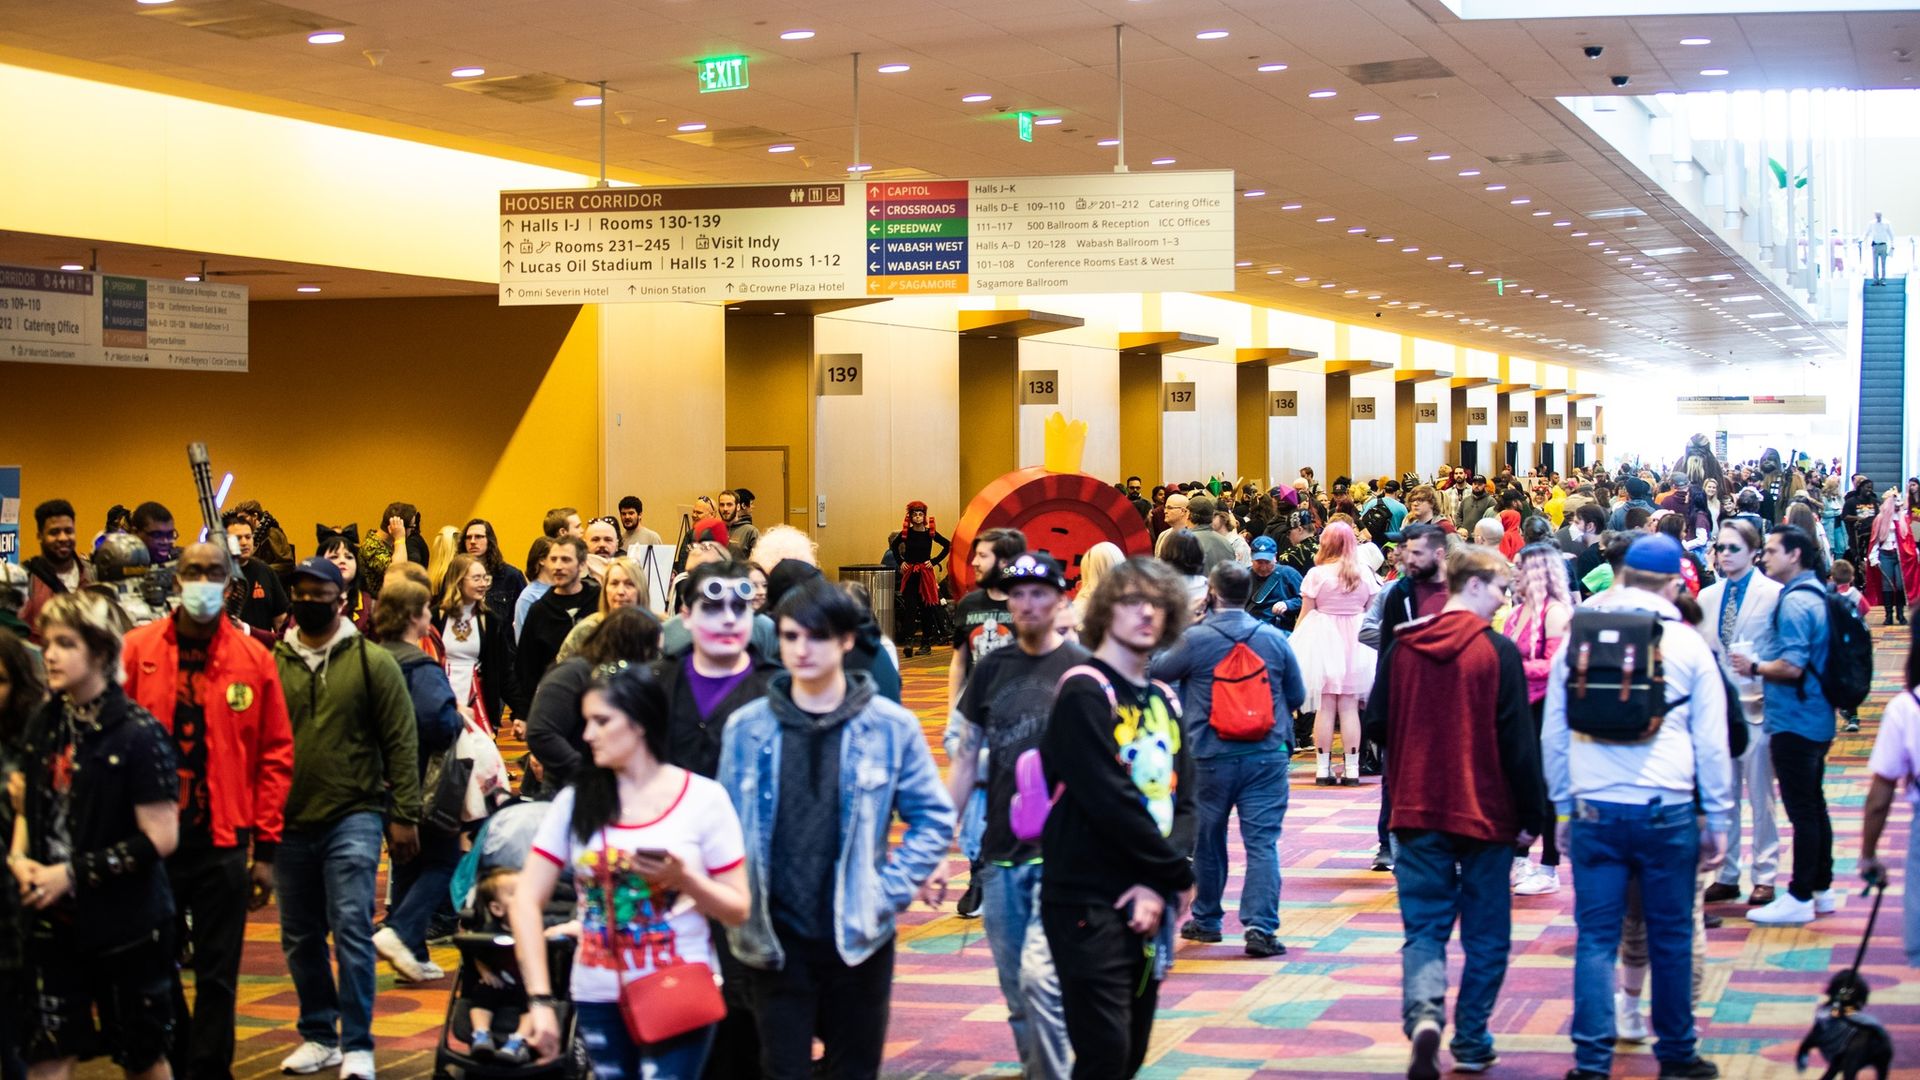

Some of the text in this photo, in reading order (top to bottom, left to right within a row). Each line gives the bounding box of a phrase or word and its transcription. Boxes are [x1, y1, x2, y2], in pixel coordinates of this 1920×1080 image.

[706, 60, 742, 88] EXIT
[888, 186, 930, 196] CAPITOL
[975, 185, 998, 194] Halls
[505, 193, 662, 210] HOOSIER CORRIDOR
[976, 203, 998, 212] Halls
[1149, 199, 1189, 210] Catering
[1192, 198, 1220, 207] Office
[887, 204, 956, 215] CROSSROADS
[521, 218, 558, 232] Halls
[600, 217, 653, 231] Rooms
[660, 215, 721, 229] 130-139
[887, 223, 942, 234] SPEEDWAY
[1027, 222, 1044, 230] 500
[1047, 220, 1089, 230] Ballroom
[1092, 220, 1099, 229] &
[1102, 219, 1149, 231] Reception
[1159, 218, 1176, 227] ICC
[1178, 217, 1210, 227] Offices
[555, 240, 603, 253] Rooms
[712, 236, 743, 250] Visit
[749, 236, 780, 251] Indy
[888, 241, 963, 252] WABASH WEST
[976, 241, 999, 250] Halls
[1076, 238, 1114, 248] Wabash
[1117, 237, 1158, 247] Ballroom
[521, 254, 841, 273] Lucas Oil Stadium Halls 1-2 Rooms 1-12
[888, 260, 961, 271] WABASH EAST
[1027, 258, 1080, 268] Conference
[1083, 258, 1116, 267] Rooms
[1119, 257, 1138, 266] East
[1141, 257, 1148, 265] &
[1150, 256, 1175, 265] West
[900, 278, 957, 289] SAGAMORE
[977, 277, 1068, 289] Sagamore Ballroom
[518, 282, 845, 298] Omni Severin Hotel Union Station Crowne Plaza Hotel
[24, 319, 56, 336] Catering
[57, 320, 79, 334] Office
[828, 367, 857, 382] 139
[1029, 381, 1054, 394] 138
[1171, 392, 1191, 402] 137
[1276, 399, 1294, 408] 136
[1357, 404, 1373, 413] 135
[0, 533, 15, 552] ENT
